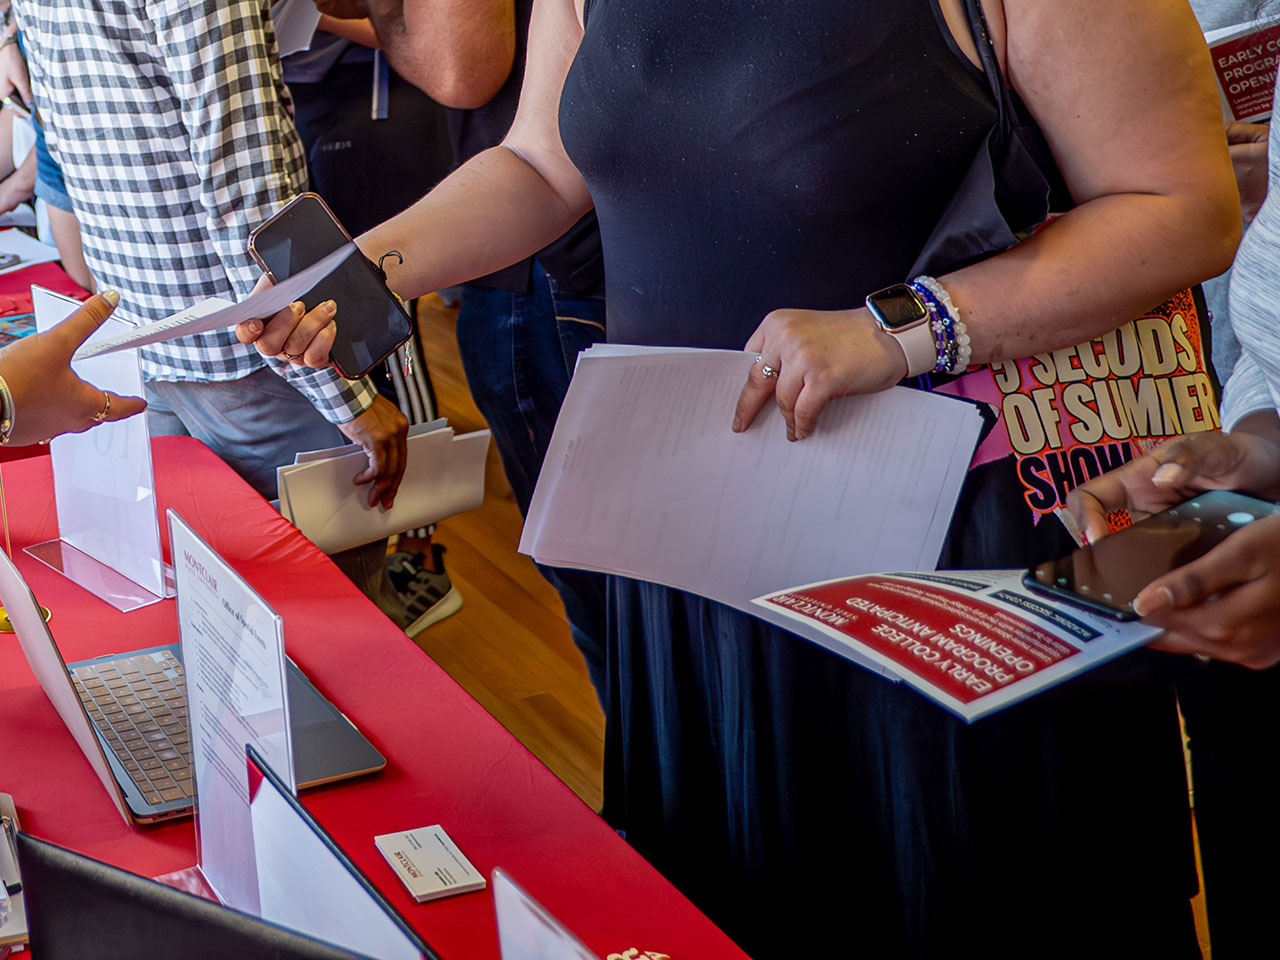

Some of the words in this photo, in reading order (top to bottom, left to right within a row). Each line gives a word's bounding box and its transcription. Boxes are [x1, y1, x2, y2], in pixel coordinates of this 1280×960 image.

[1218, 45, 1263, 68] EARLY
[1229, 70, 1277, 94] OPENI
[1002, 386, 1062, 455] OF
[772, 594, 850, 626] MONTCLAIR
[846, 597, 937, 637] ANTICIPATED
[871, 623, 940, 661] COLLEGE
[929, 633, 1014, 683] PROGRAM
[949, 623, 1034, 672] OPENINGS
[935, 658, 992, 692] EARLY
